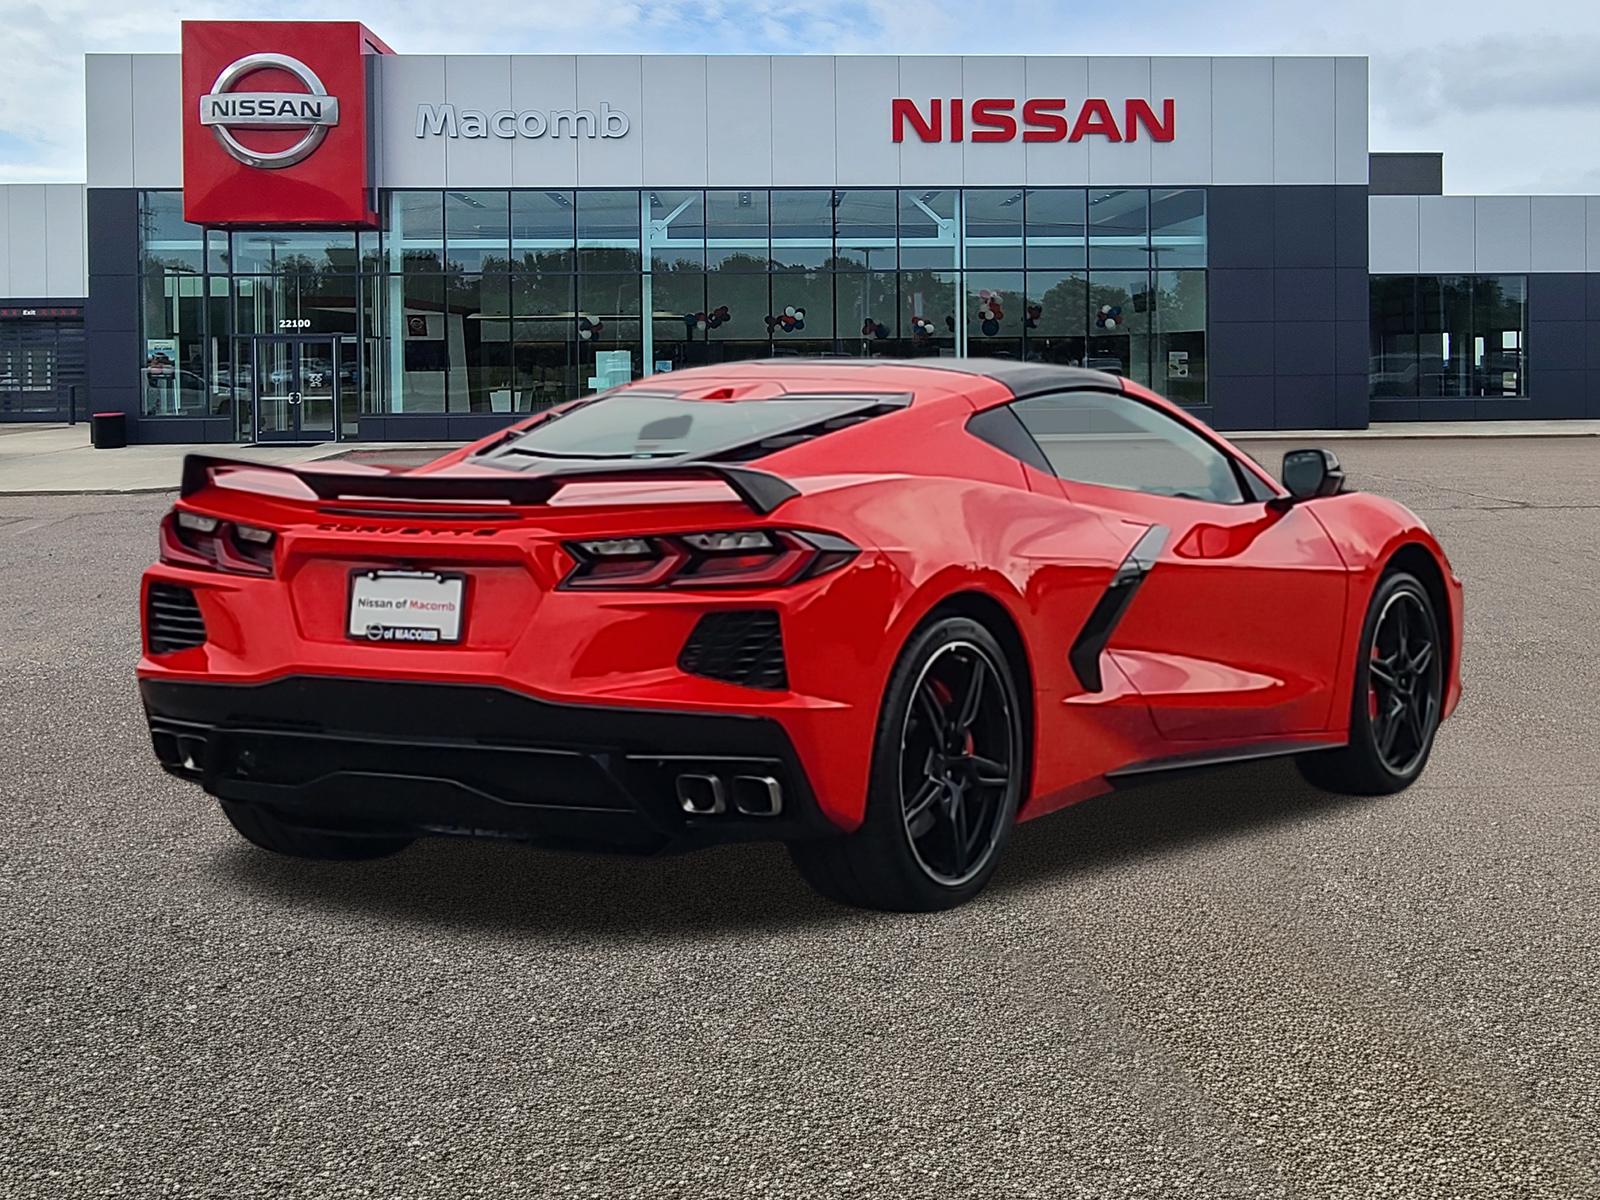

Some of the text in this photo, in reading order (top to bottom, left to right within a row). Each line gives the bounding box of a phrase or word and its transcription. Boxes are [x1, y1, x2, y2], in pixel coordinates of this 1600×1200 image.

[211, 99, 322, 118] NISSAN
[415, 102, 630, 139] Macomb
[892, 98, 1175, 143] NISSAN
[279, 319, 311, 328] 22100
[317, 523, 497, 536] CORVETTE
[358, 598, 456, 612] Nissan of Macomb
[383, 628, 394, 639] of
